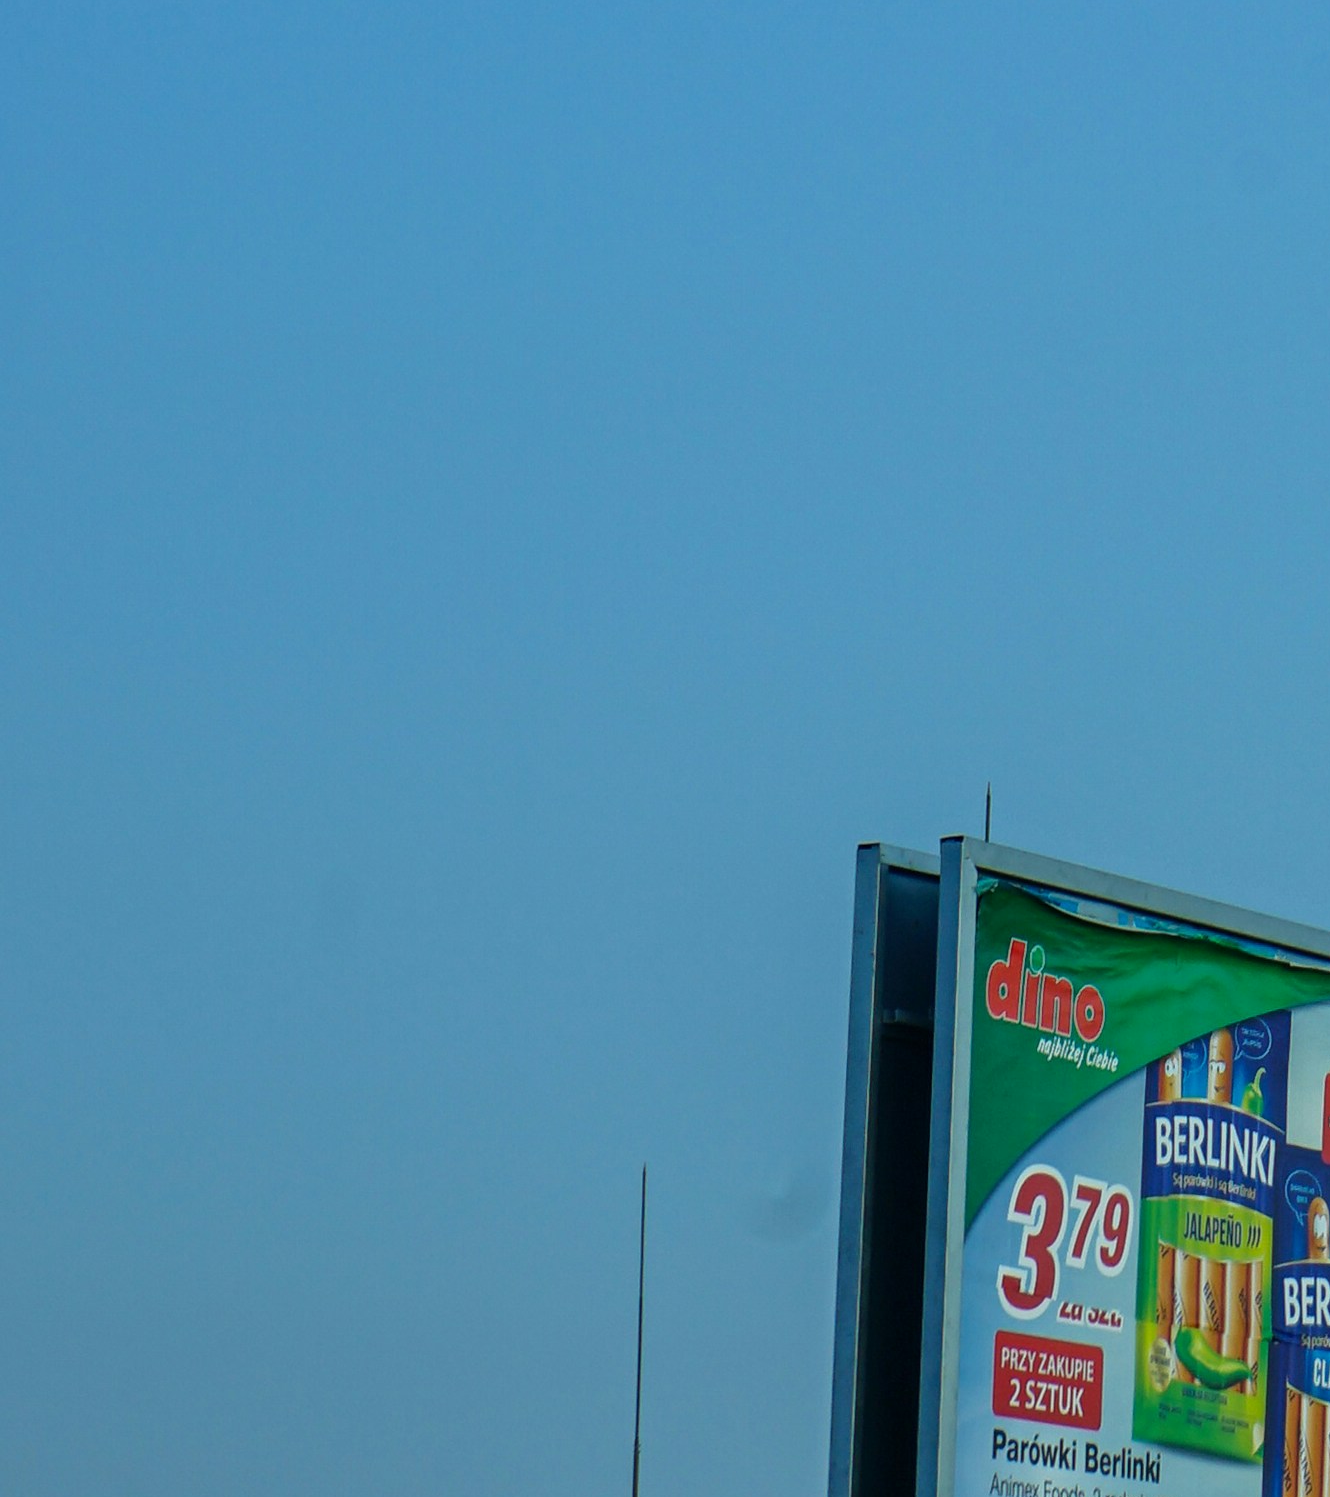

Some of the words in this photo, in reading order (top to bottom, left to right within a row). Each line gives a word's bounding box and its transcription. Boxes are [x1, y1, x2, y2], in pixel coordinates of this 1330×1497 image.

[986, 937, 1105, 1042] dino
[1037, 1037, 1084, 1069] najbliżej
[1086, 1045, 1119, 1072] Ciebie
[1155, 1115, 1276, 1186] BERLINKI
[1184, 1211, 1243, 1247] JALAPEÑO
[1001, 1347, 1037, 1373] PRZY
[1038, 1353, 1095, 1382] ZAKUPIE
[1009, 1378, 1021, 1407] 2
[1025, 1380, 1084, 1417] SZTUK
[991, 1428, 1077, 1471] Parówki
[1085, 1443, 1161, 1484] Berlinki
